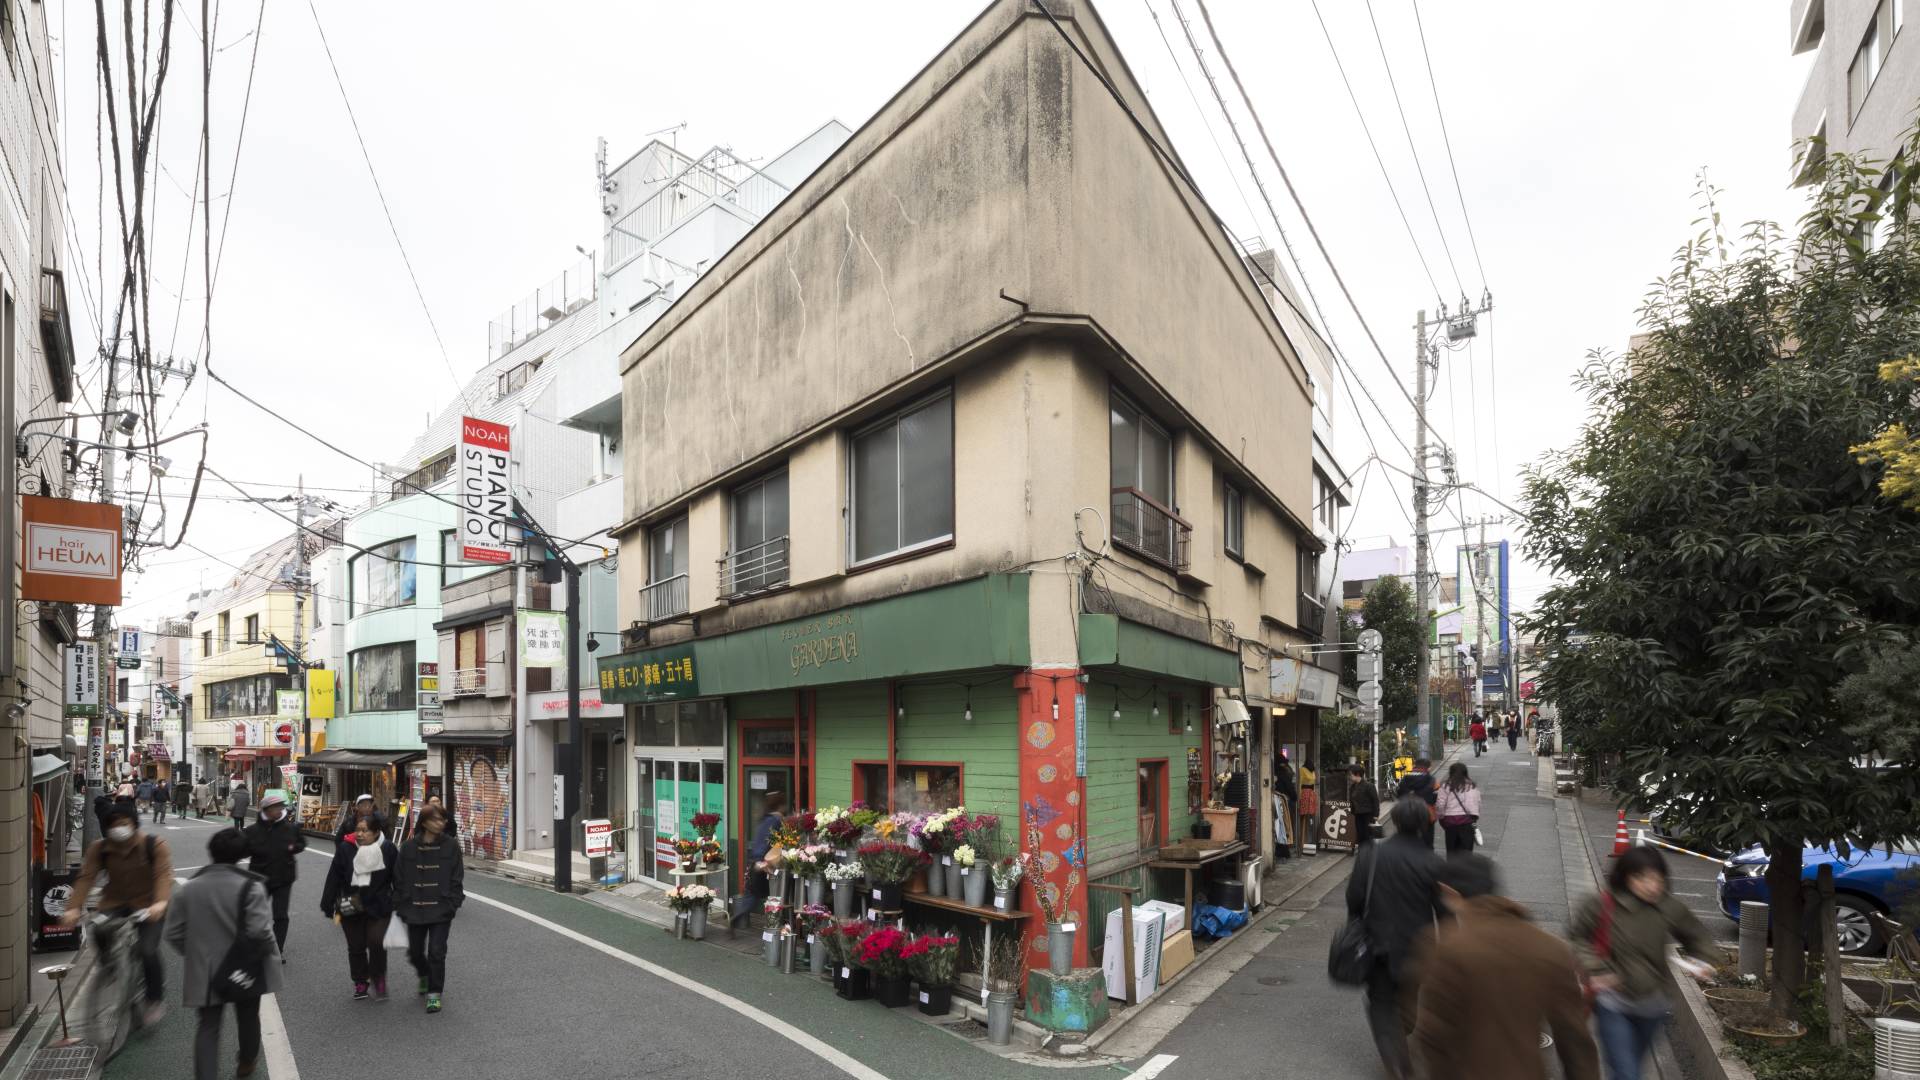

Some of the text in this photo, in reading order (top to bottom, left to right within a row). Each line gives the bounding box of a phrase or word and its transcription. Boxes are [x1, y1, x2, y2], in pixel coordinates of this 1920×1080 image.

[465, 425, 508, 444] NOAH
[466, 449, 483, 535] STUDIO
[487, 453, 507, 540] PIANO
[38, 546, 106, 566] HEUM
[59, 536, 85, 548] hair
[75, 644, 84, 702] ARTIST
[790, 631, 858, 676] GARDENA
